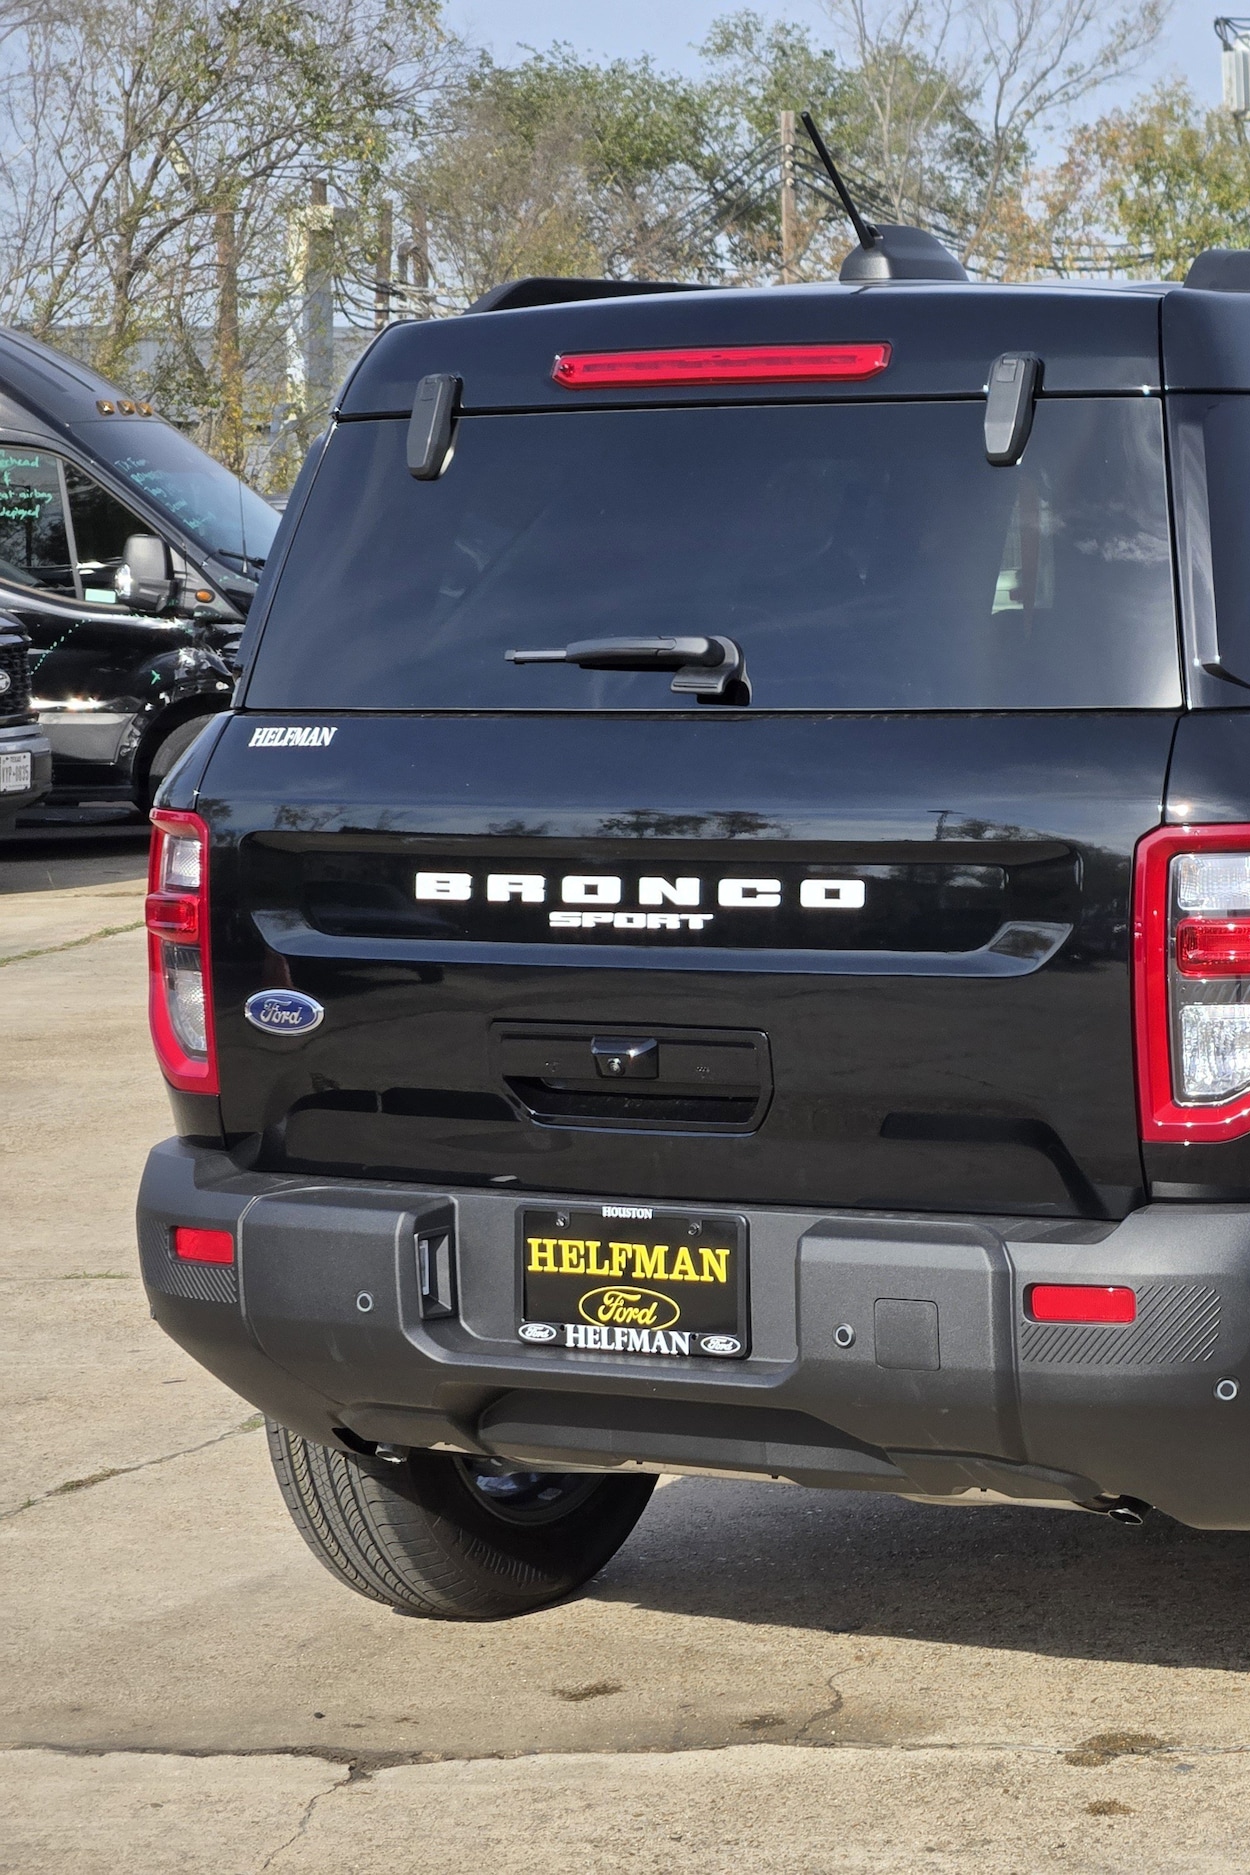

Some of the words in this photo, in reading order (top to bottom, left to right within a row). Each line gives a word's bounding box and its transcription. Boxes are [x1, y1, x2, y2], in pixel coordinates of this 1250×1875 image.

[248, 727, 338, 747] HELFMAN
[415, 871, 866, 908] BRONCO
[549, 911, 714, 930] SPORT
[602, 1206, 653, 1220] HOUSTON
[527, 1238, 730, 1283] HELFMAN
[597, 1290, 657, 1325] Ford
[564, 1323, 691, 1355] HELFMAN
